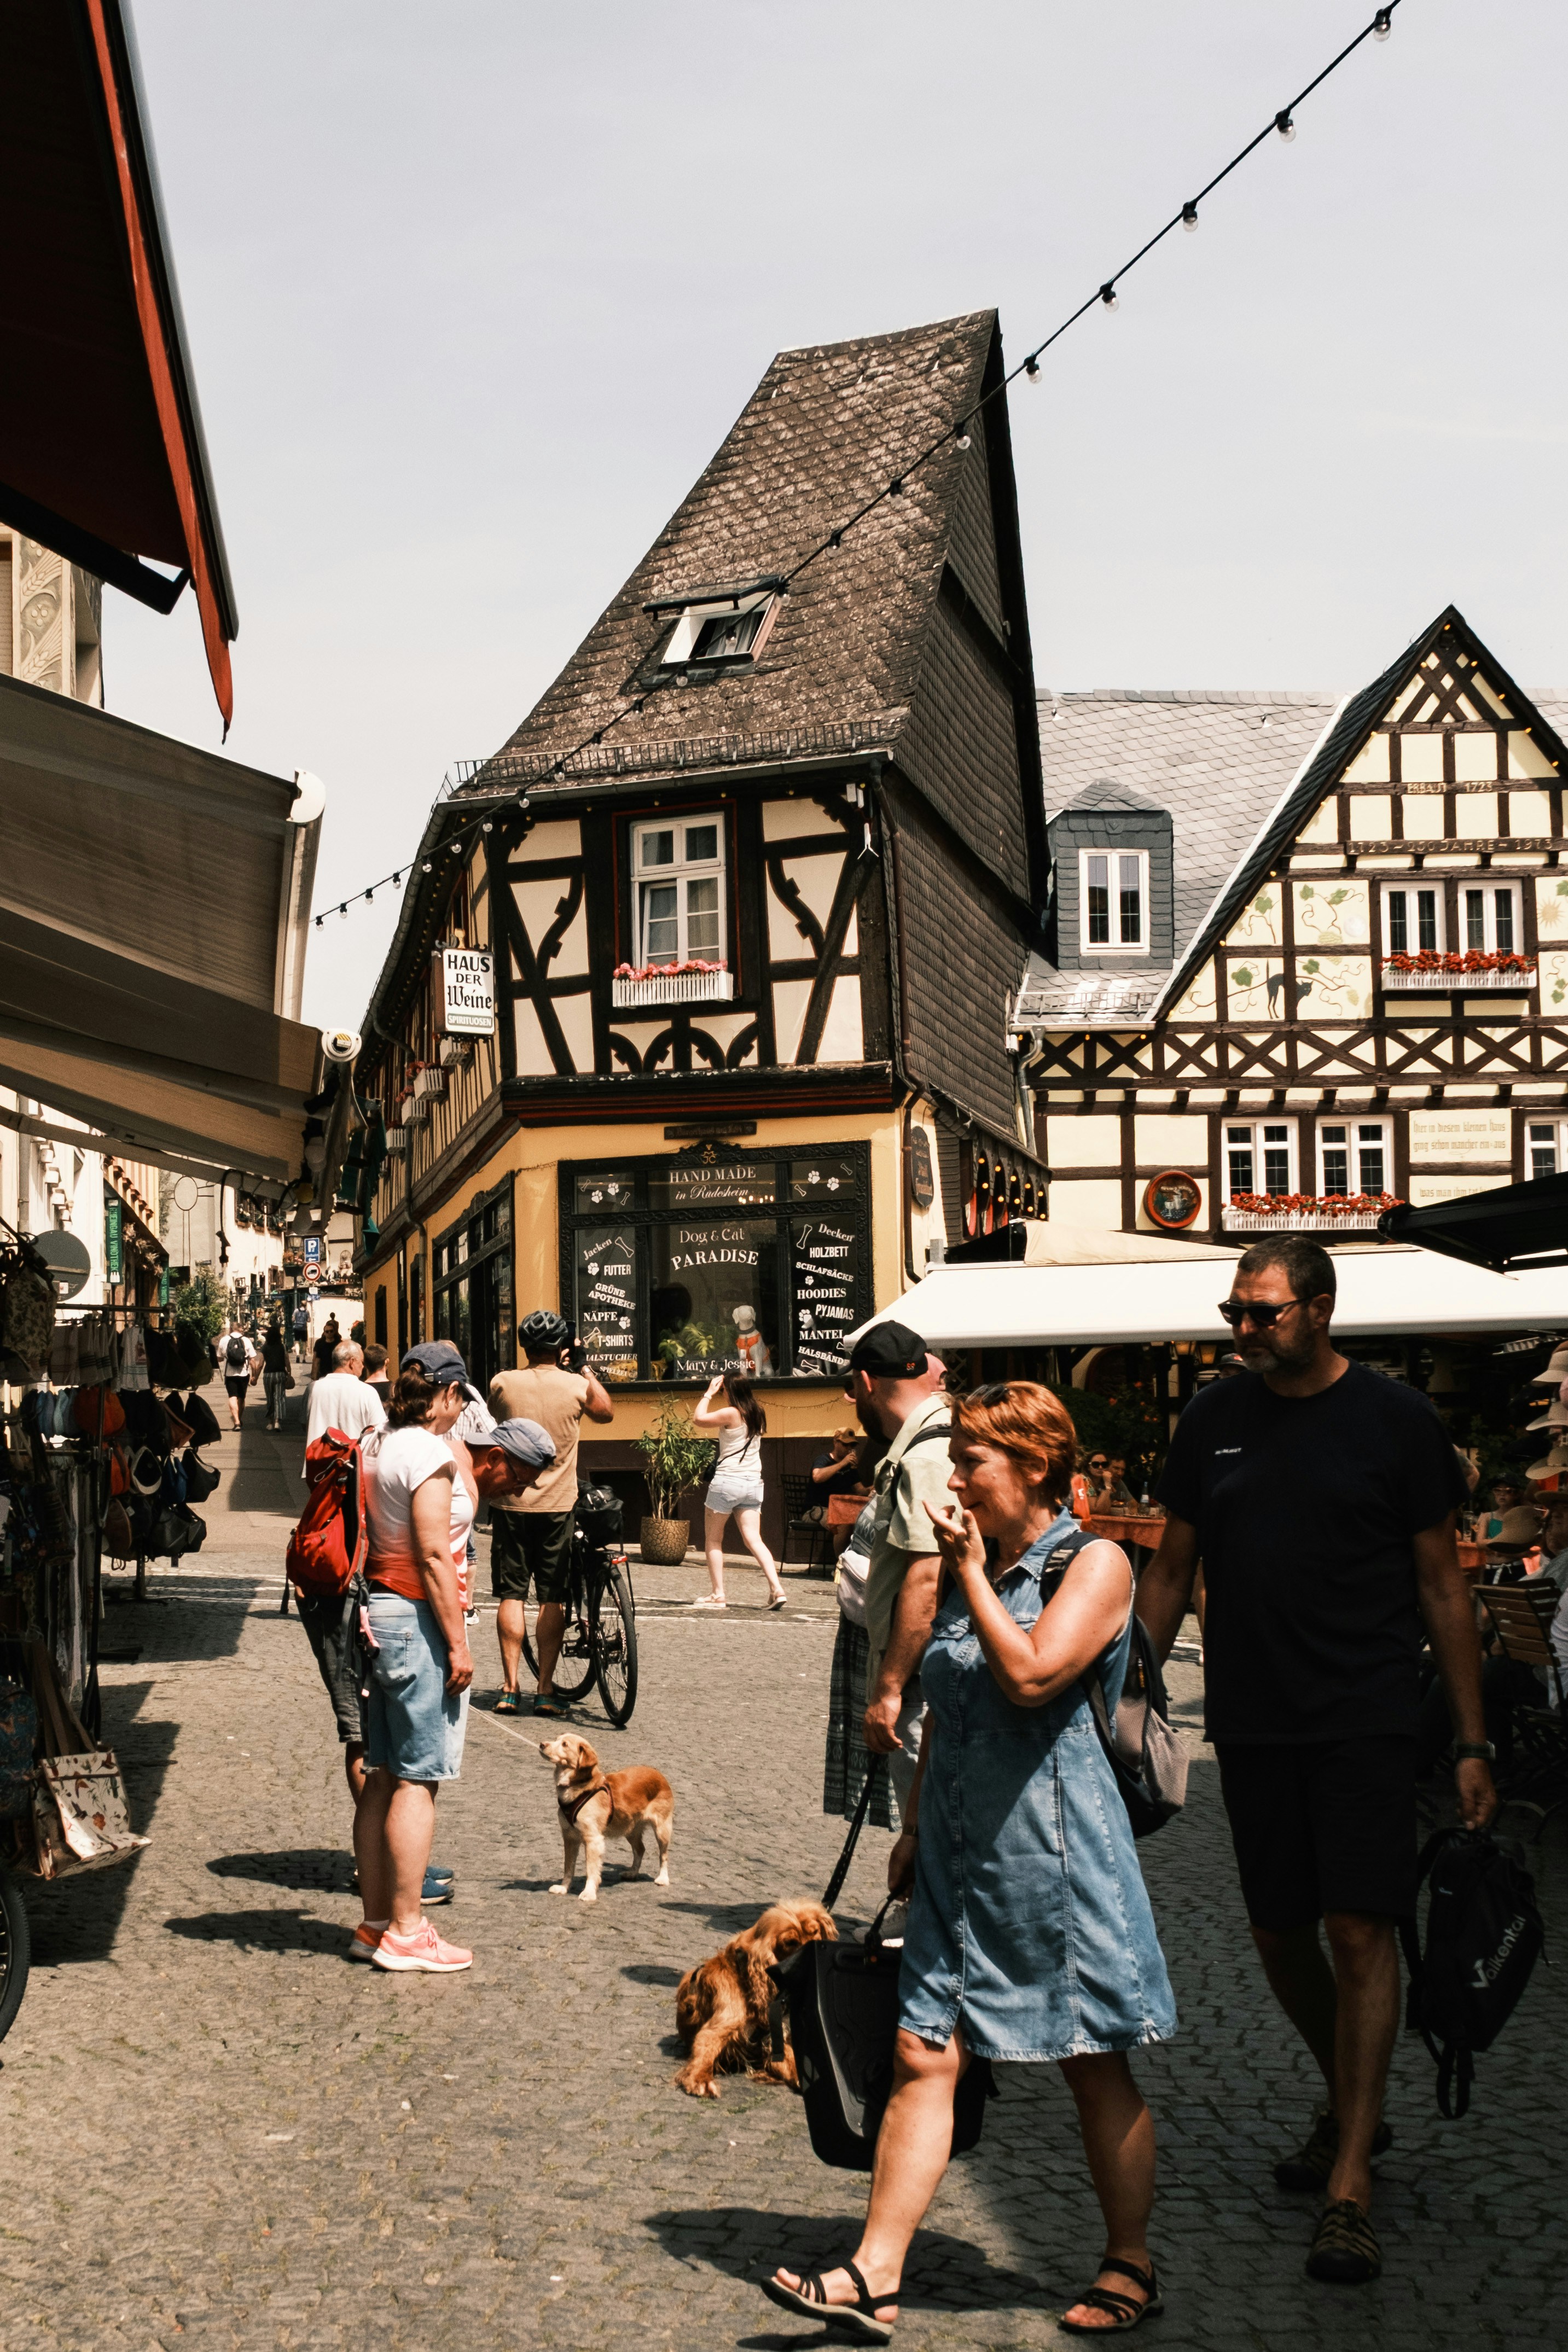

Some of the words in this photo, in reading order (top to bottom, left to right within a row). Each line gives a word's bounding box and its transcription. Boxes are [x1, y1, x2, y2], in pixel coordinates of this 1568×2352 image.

[1465, 781, 1493, 792] 1723
[1348, 841, 1390, 853] 1723
[1439, 840, 1495, 852] JAHRE
[1515, 839, 1553, 850] 1973
[448, 954, 491, 973] HAUS
[456, 973, 483, 986] DER
[447, 985, 492, 1009] Weine
[448, 1014, 492, 1026] SPIRITUOSEN
[670, 1170, 711, 1183] HAND
[715, 1166, 757, 1181] MADE
[675, 1190, 686, 1200] in
[680, 1230, 708, 1246] Dog
[711, 1230, 719, 1241] &
[721, 1228, 745, 1241] Cat
[818, 1223, 855, 1242] Decken
[307, 1240, 317, 1252] P
[583, 1239, 613, 1261] Jacken
[809, 1246, 849, 1258] HOLZBETT
[671, 1248, 759, 1270] PARADISE
[603, 1264, 631, 1276] FUTTER
[795, 1262, 854, 1282] SCHLAFSÄCKE
[595, 1282, 626, 1298] GRÜNE
[797, 1288, 846, 1299] HOODIES
[588, 1290, 636, 1310] APOTHEKE
[583, 1310, 618, 1322] NÄPFE
[815, 1304, 855, 1320] PYJAMAS
[597, 1334, 634, 1347] T-SHIRTS
[677, 1359, 708, 1373] Mary
[710, 1360, 718, 1370] &
[719, 1358, 756, 1372] Jessie
[1471, 1913, 1526, 1988] Valkental
